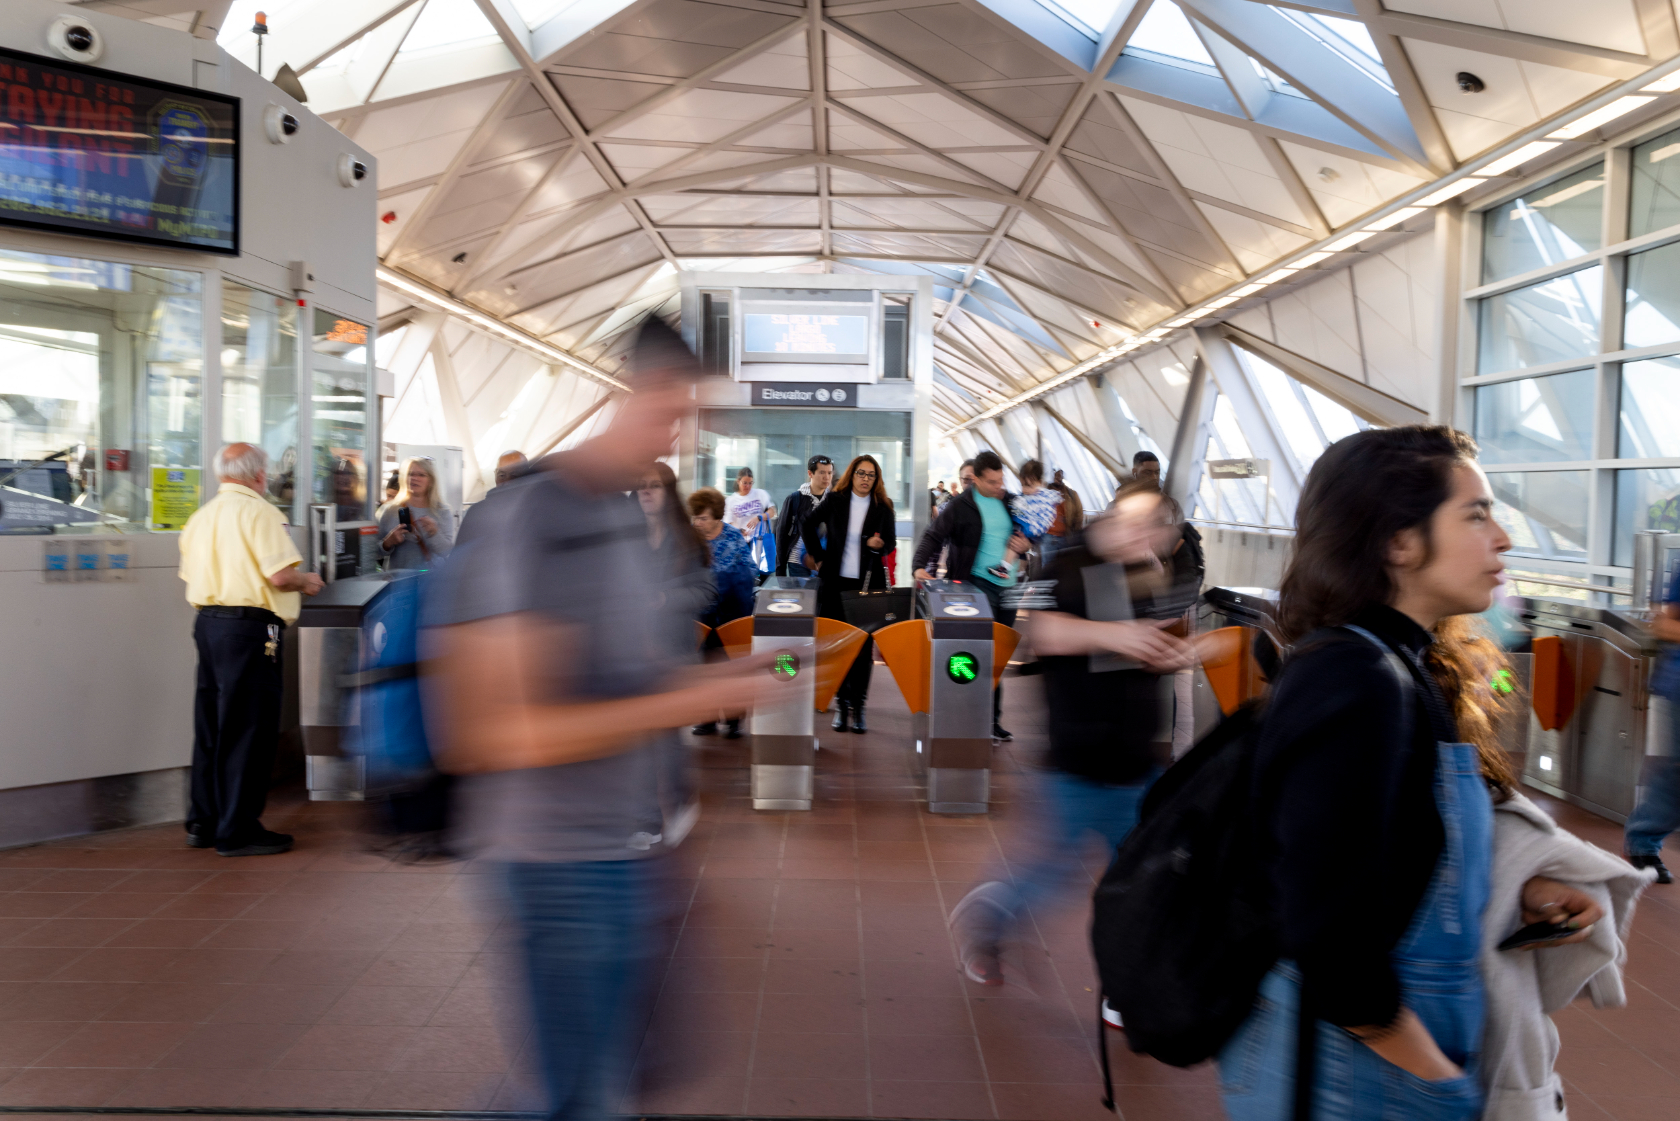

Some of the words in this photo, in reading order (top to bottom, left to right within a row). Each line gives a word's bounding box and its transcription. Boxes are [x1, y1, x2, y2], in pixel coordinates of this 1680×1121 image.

[42, 72, 85, 94] YOU
[96, 83, 136, 105] FOR
[761, 388, 814, 401] Elevator
